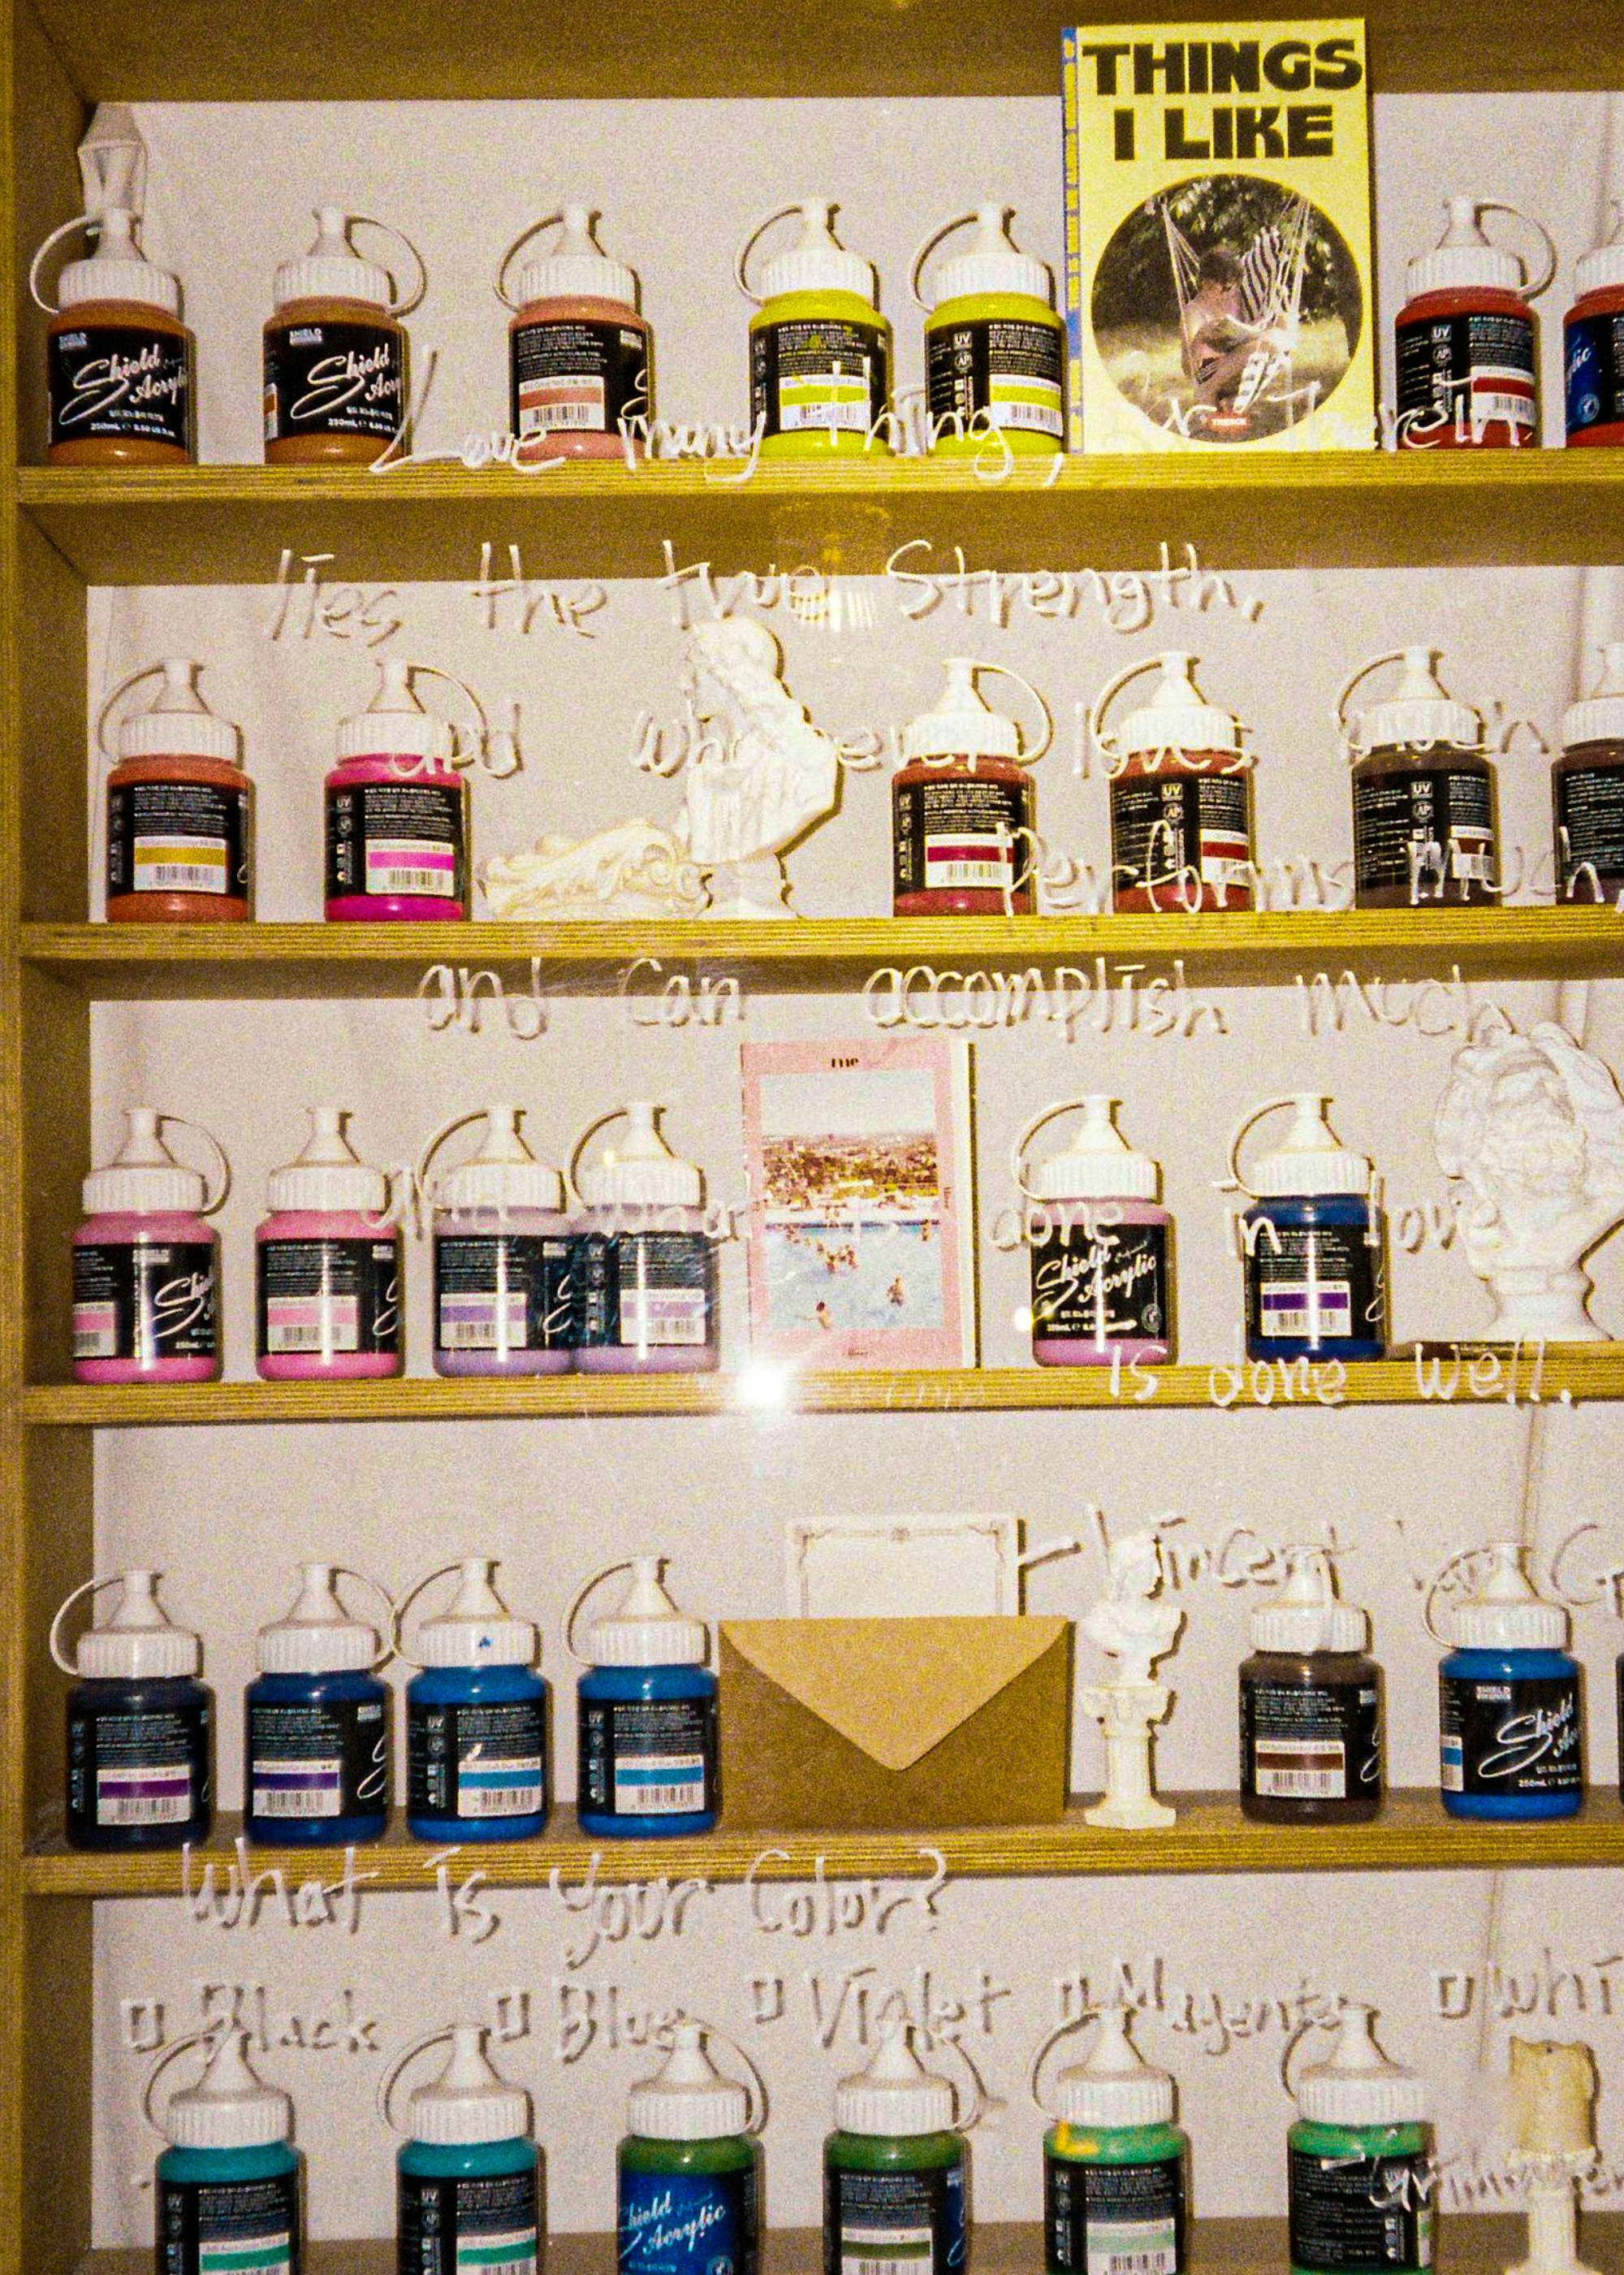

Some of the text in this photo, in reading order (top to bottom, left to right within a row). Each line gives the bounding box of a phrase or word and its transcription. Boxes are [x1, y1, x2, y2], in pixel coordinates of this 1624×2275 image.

[1082, 39, 1363, 96] THINGS
[1114, 105, 1333, 161] I LIKE
[956, 334, 970, 344] UV
[1434, 327, 1450, 339] UV
[59, 344, 161, 425] Shield
[290, 343, 390, 419] Shield
[471, 541, 608, 639] the
[1164, 785, 1181, 798] UV
[1414, 784, 1431, 794] UV
[416, 957, 549, 1041] and
[862, 957, 1228, 1044] accomplish
[1110, 1343, 1169, 1401] is
[1207, 1326, 1348, 1407] done
[1478, 1693, 1574, 1778] Shield
[422, 1845, 500, 1944] is
[641, 2204, 727, 2254] Acrylic
